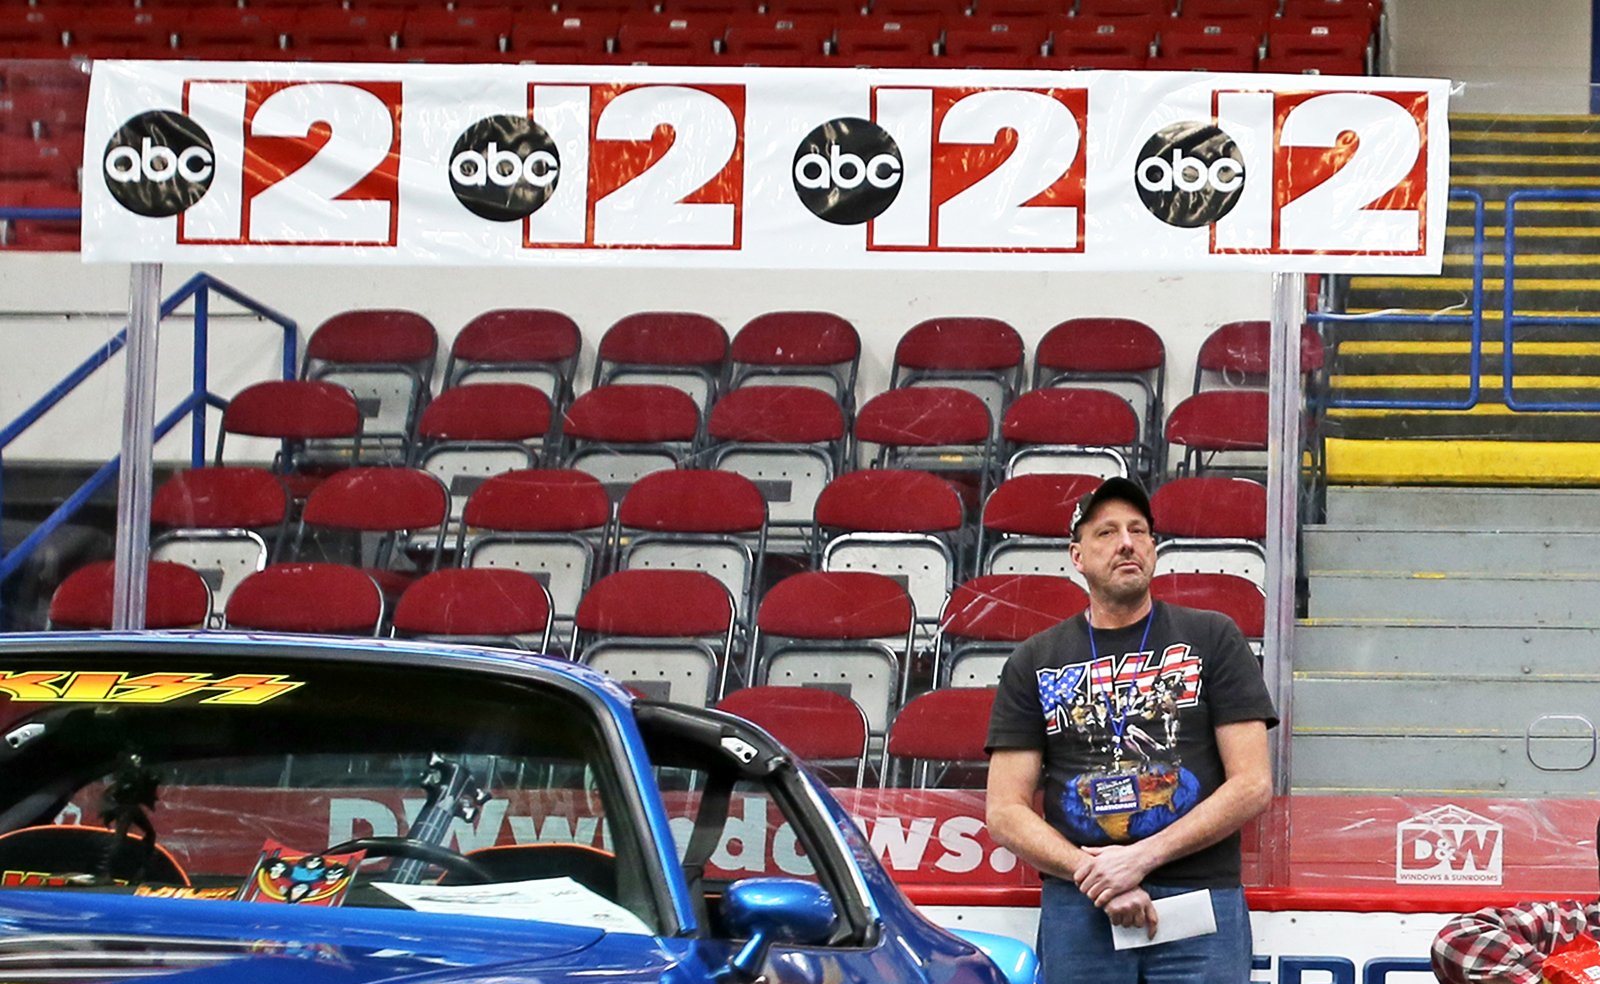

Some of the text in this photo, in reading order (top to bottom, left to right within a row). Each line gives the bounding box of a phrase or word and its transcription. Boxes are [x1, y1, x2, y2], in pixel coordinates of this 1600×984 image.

[105, 81, 1424, 253] abc 12 abc 12 abc 12 abc 12
[1402, 829, 1499, 870] D&W
[1400, 873, 1498, 882] WINDOWS & SUNROOMS
